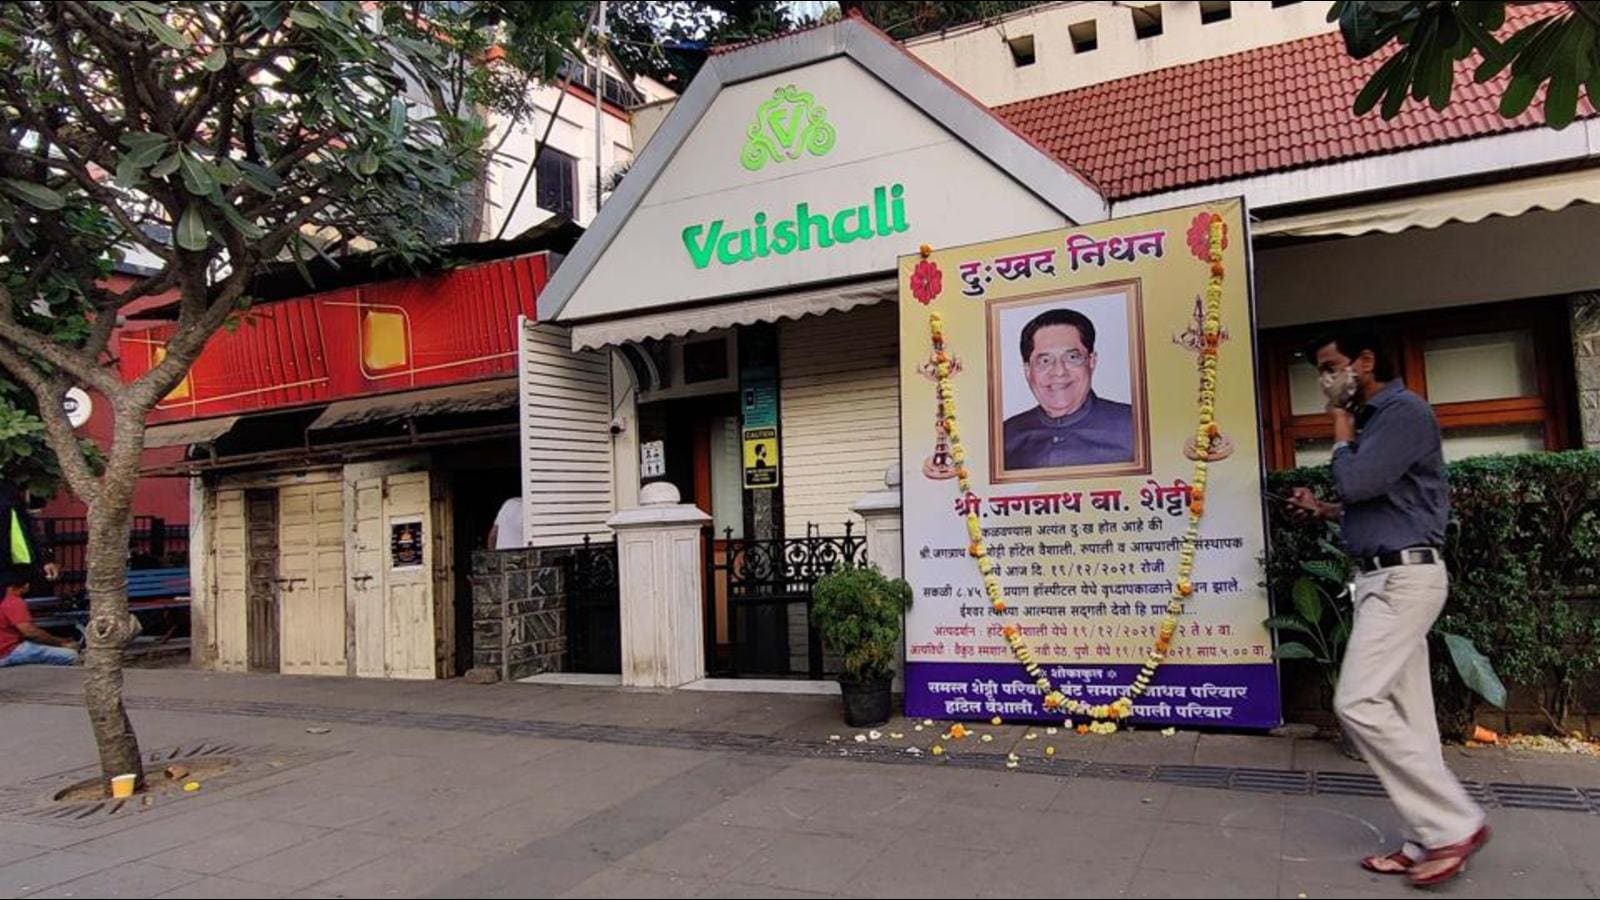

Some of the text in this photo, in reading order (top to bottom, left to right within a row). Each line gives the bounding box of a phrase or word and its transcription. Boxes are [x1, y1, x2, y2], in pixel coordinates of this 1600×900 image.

[682, 183, 910, 269] Vaishali
[959, 231, 1166, 296] दुःखद निधन
[1140, 479, 1193, 517] शेट्टी
[1037, 523, 1066, 536] अत्यंत
[1097, 518, 1118, 535] होत
[1122, 517, 1144, 532] आहे
[1147, 515, 1163, 531] की
[1009, 541, 1035, 557] हॉटेल
[1118, 542, 1126, 553] व
[1194, 535, 1243, 551] संस्थापक
[1006, 564, 1027, 577] आज
[1140, 558, 1165, 574] रोजी
[1111, 601, 1131, 616] देवो
[1179, 625, 1186, 637] २
[1191, 622, 1200, 636] ते
[1204, 625, 1212, 636] ४
[928, 681, 968, 695] समस्त
[1190, 682, 1247, 700] परिवार
[1176, 701, 1233, 719] परिवार
